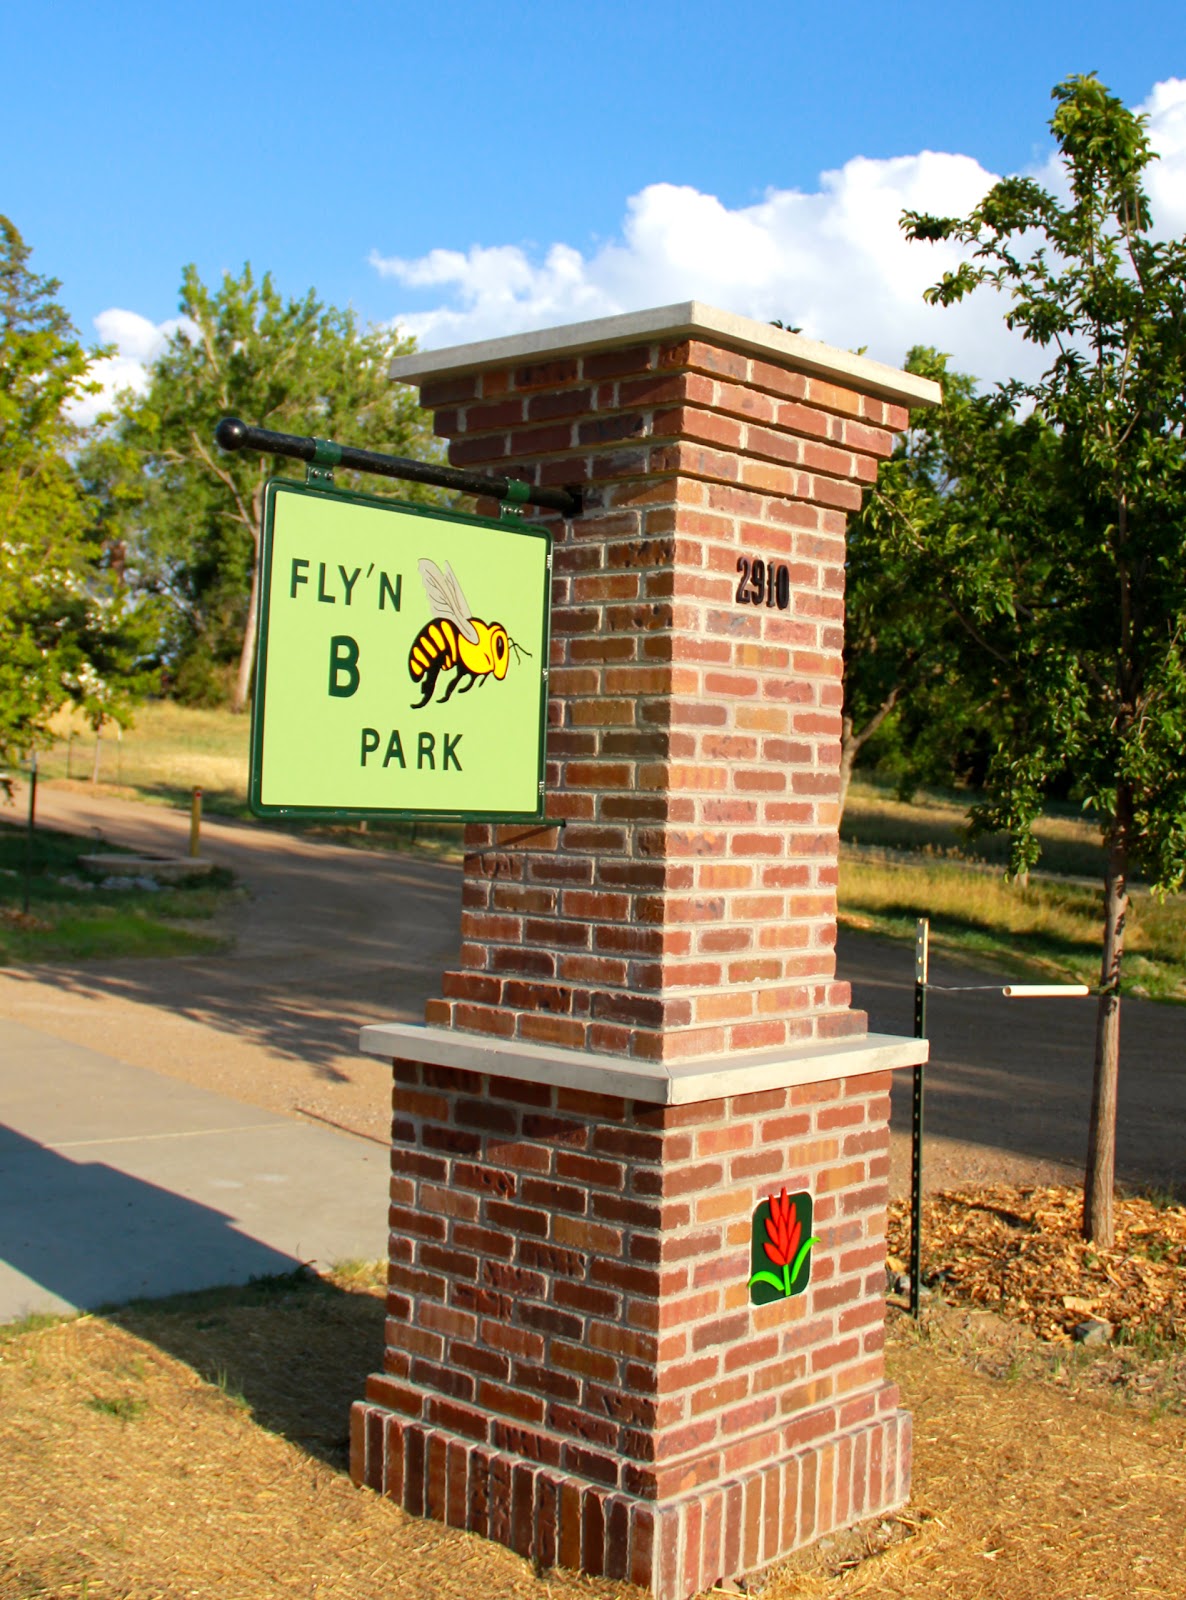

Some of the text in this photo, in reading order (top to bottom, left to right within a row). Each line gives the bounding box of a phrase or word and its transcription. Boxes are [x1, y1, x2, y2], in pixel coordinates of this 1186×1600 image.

[290, 558, 402, 612] FLY'N
[735, 556, 790, 610] 2910
[328, 635, 360, 698] B
[360, 727, 463, 771] PARK
